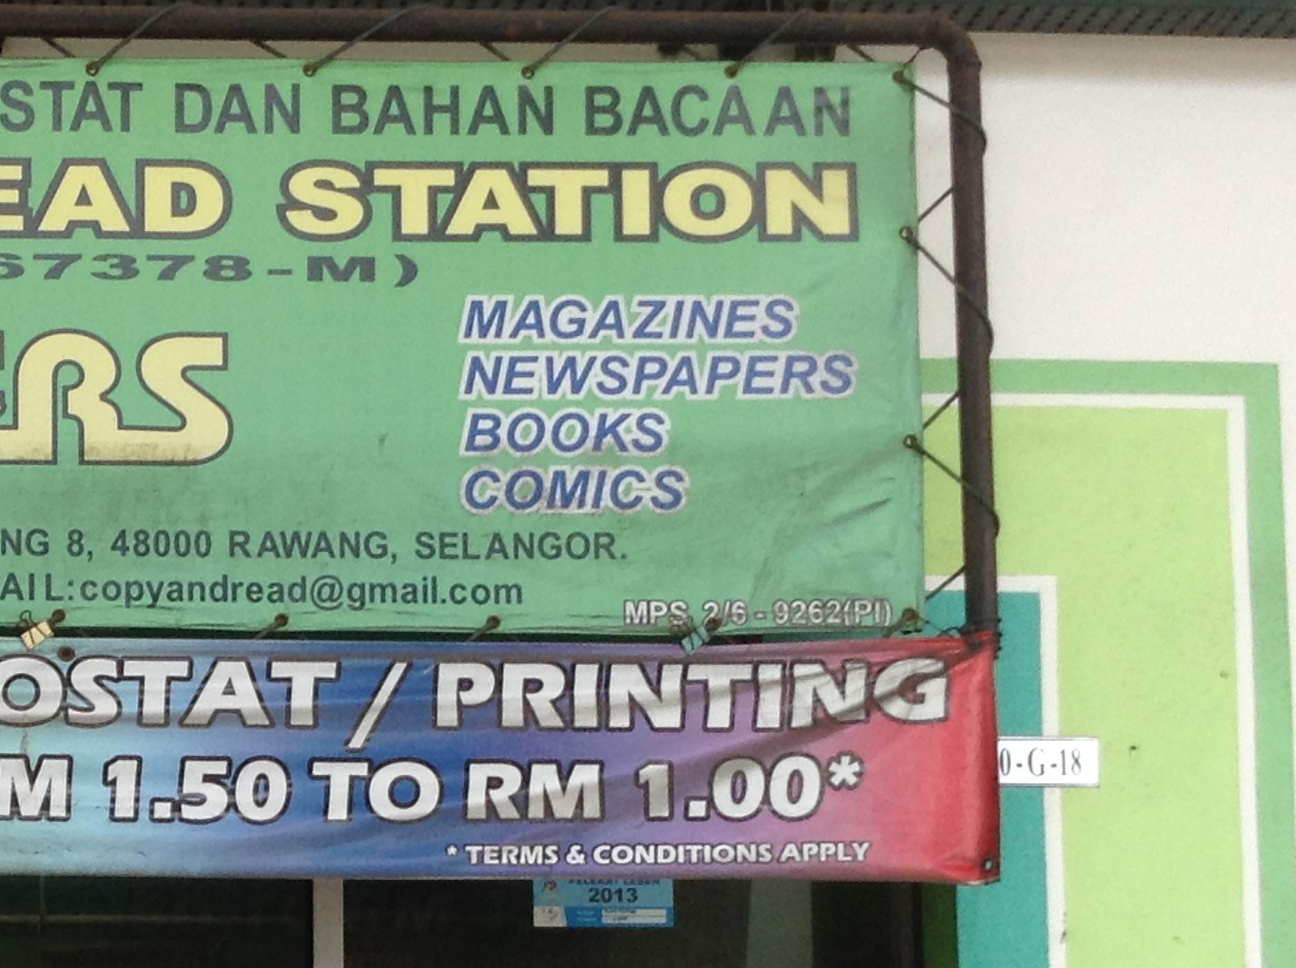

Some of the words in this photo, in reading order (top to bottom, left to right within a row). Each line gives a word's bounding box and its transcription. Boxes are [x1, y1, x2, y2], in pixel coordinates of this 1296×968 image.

[173, 83, 303, 134] DAN
[330, 84, 556, 136] BAHAN
[583, 85, 853, 138] BACAAN
[279, 160, 861, 244] STATION
[458, 293, 800, 343] MAGAZINES
[458, 351, 857, 401] NEWSPAPERS
[458, 408, 671, 458] BOOKS
[458, 466, 690, 516] COMICS
[65, 531, 95, 562] 8,
[111, 532, 214, 560] 48000
[228, 532, 399, 565] RAWANG,
[414, 532, 629, 562] SELANGOR.
[703, 600, 748, 624] 2/6
[773, 599, 893, 626] 9262(PI)
[344, 658, 410, 754] /
[431, 650, 952, 734] PRINTING
[102, 755, 292, 824] 1.50
[310, 760, 442, 824] TO
[465, 759, 604, 824] RM
[464, 844, 560, 866] TERMS
[565, 844, 587, 866] &
[592, 843, 775, 867] CONDITIONS
[778, 841, 871, 865] APPLY
[588, 887, 639, 903] 2013
